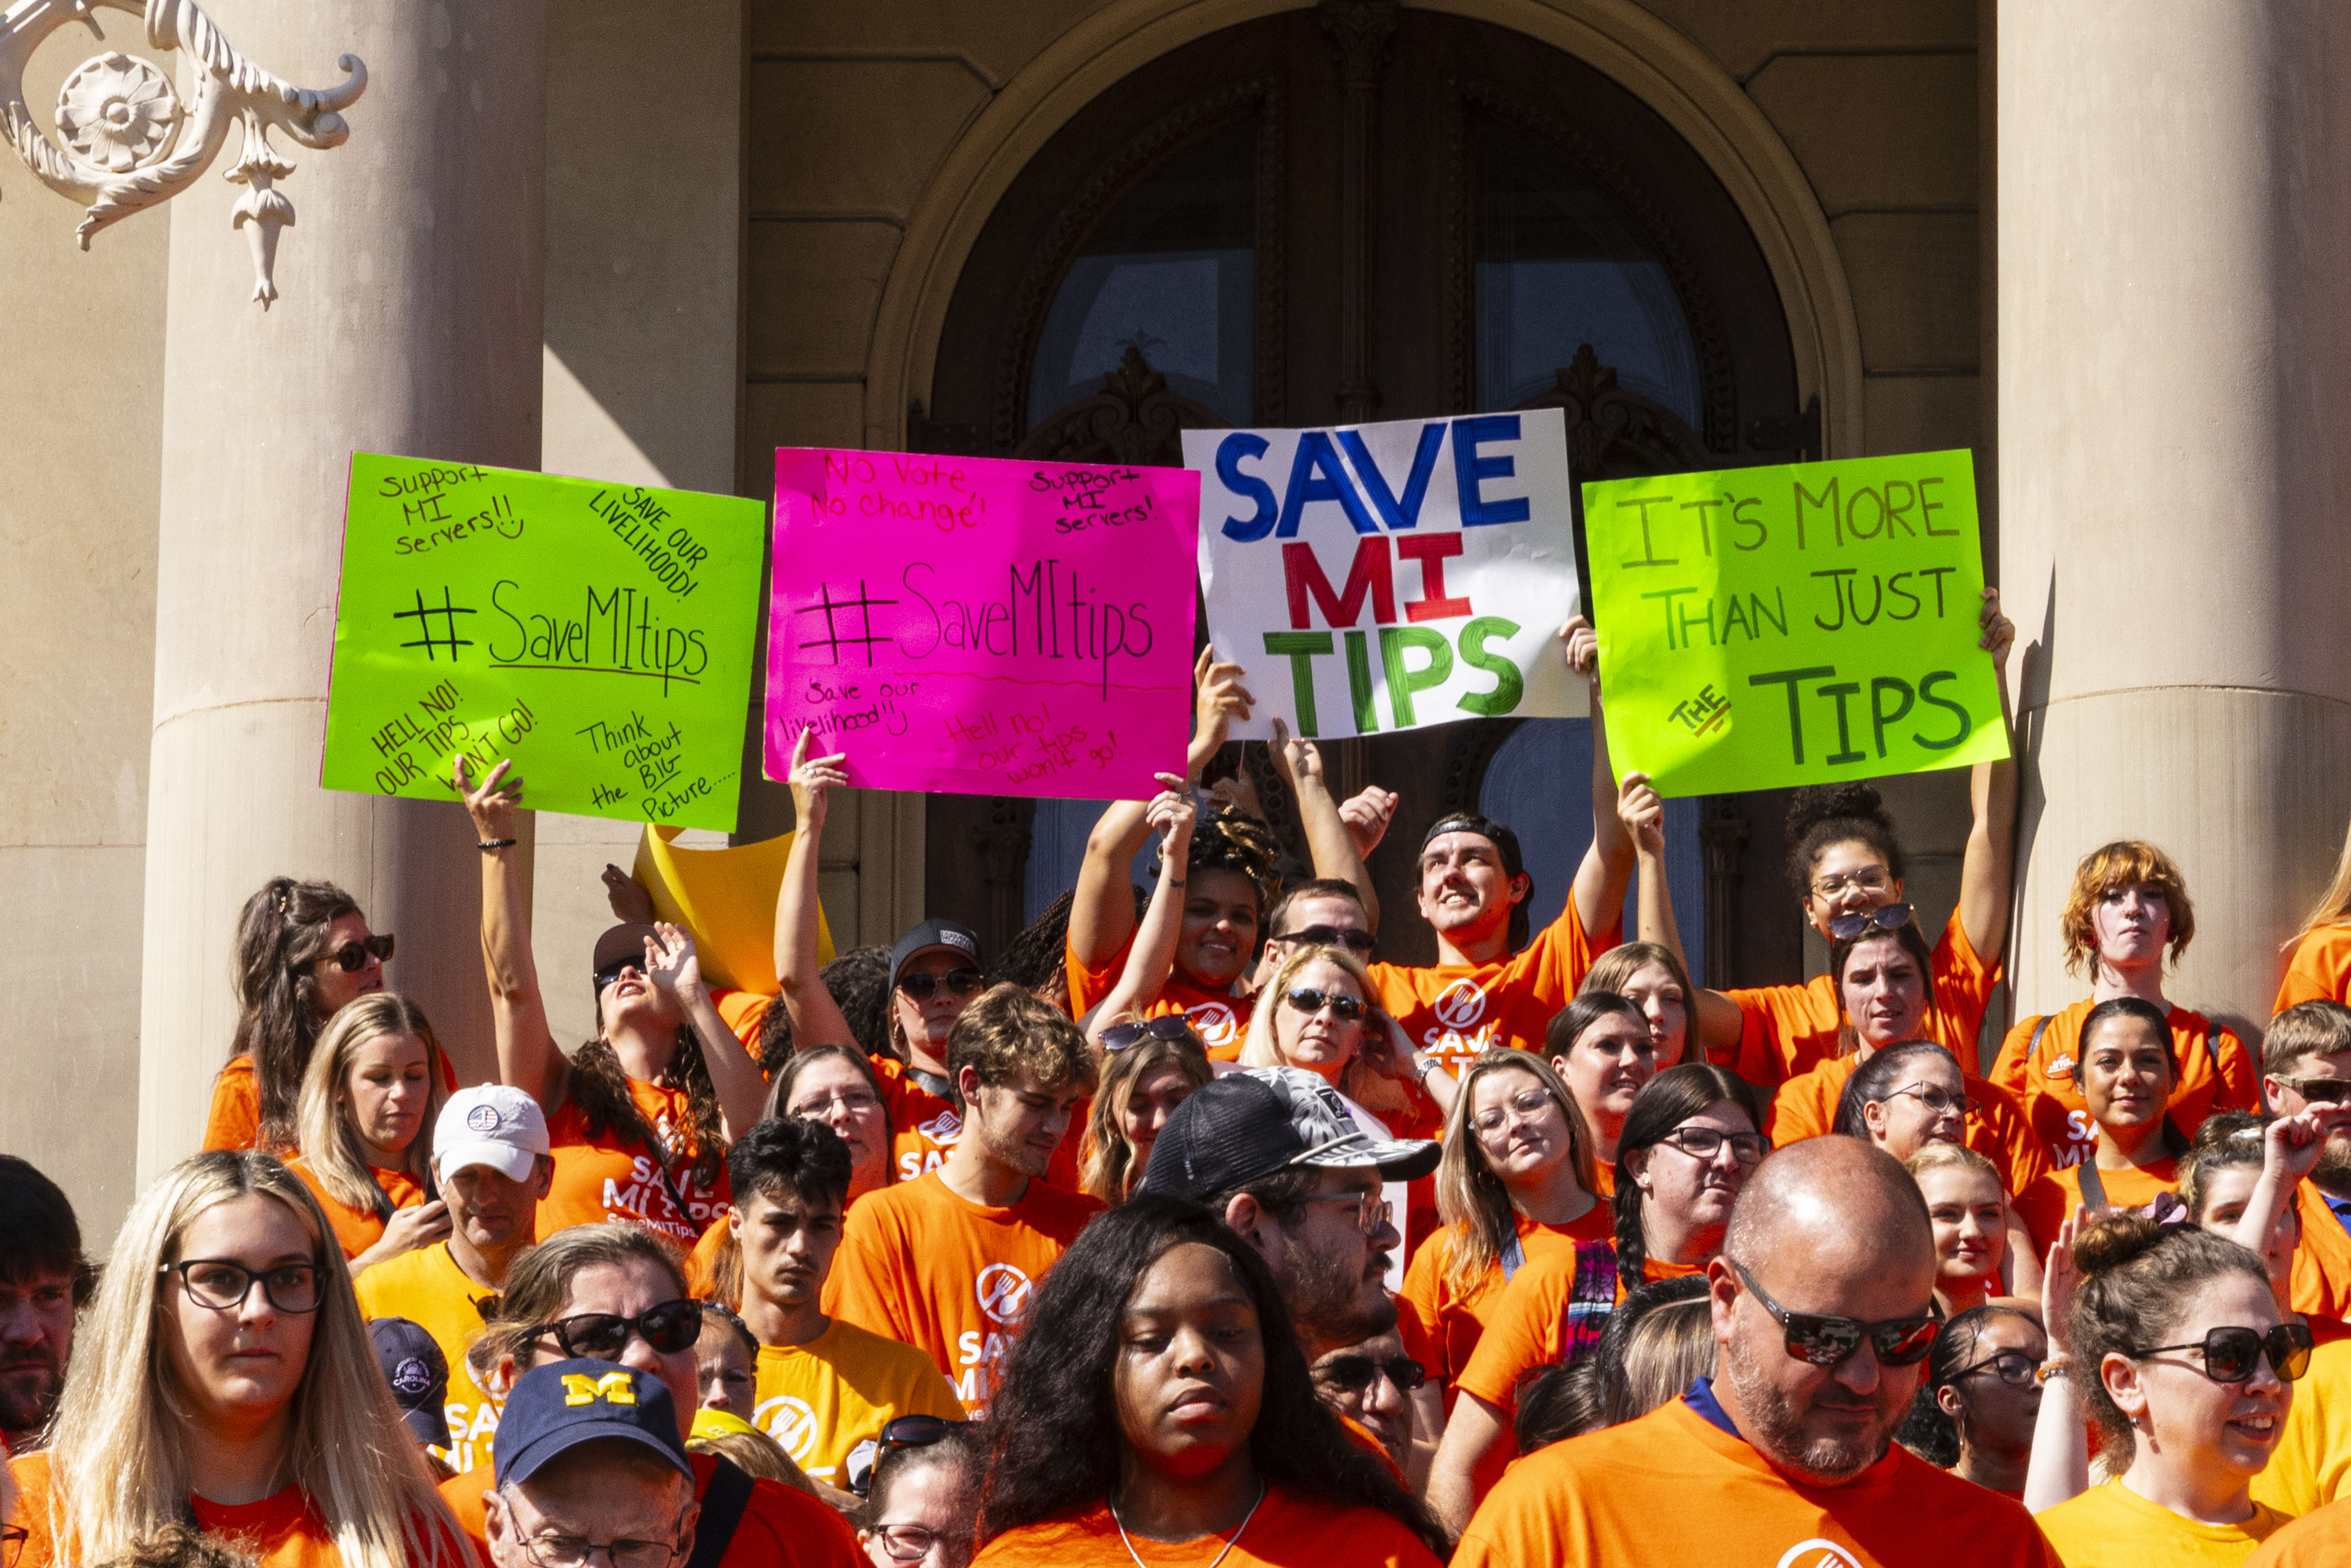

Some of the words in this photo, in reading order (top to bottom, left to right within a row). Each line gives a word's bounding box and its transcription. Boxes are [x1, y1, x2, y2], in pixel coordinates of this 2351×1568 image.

[1062, 490, 1107, 510] MI
[1215, 414, 1530, 542] SAVE
[403, 493, 452, 525] MI
[624, 487, 670, 531] SAVE
[669, 528, 708, 570] OUR
[1616, 493, 1767, 569] IT'S
[1793, 476, 1960, 551] MORE
[589, 490, 699, 602] LIVELIHOOD!
[1282, 531, 1473, 629] MI
[1641, 585, 1788, 650] THAN
[1810, 567, 1956, 630] JUST
[806, 682, 862, 704] Save
[880, 682, 920, 698] our
[1263, 616, 1524, 738] TIPS
[371, 713, 422, 759] HELL
[418, 679, 464, 722] NO!
[498, 697, 538, 745] GO!
[575, 710, 651, 753] Think
[944, 710, 998, 744] Hell
[1011, 701, 1058, 735] no!
[1668, 684, 1726, 730] THE
[1749, 666, 1972, 765] TIPS
[375, 753, 427, 795] OUR
[418, 715, 470, 760] TIPS
[624, 722, 682, 769] about
[979, 743, 1020, 771] our
[1037, 722, 1086, 754] tips
[1007, 746, 1075, 785] won't
[1090, 730, 1124, 770] go!
[592, 783, 628, 810] the
[639, 755, 682, 788] BIG
[393, 1376, 430, 1386] CAROLINA
[561, 1372, 636, 1407] M
